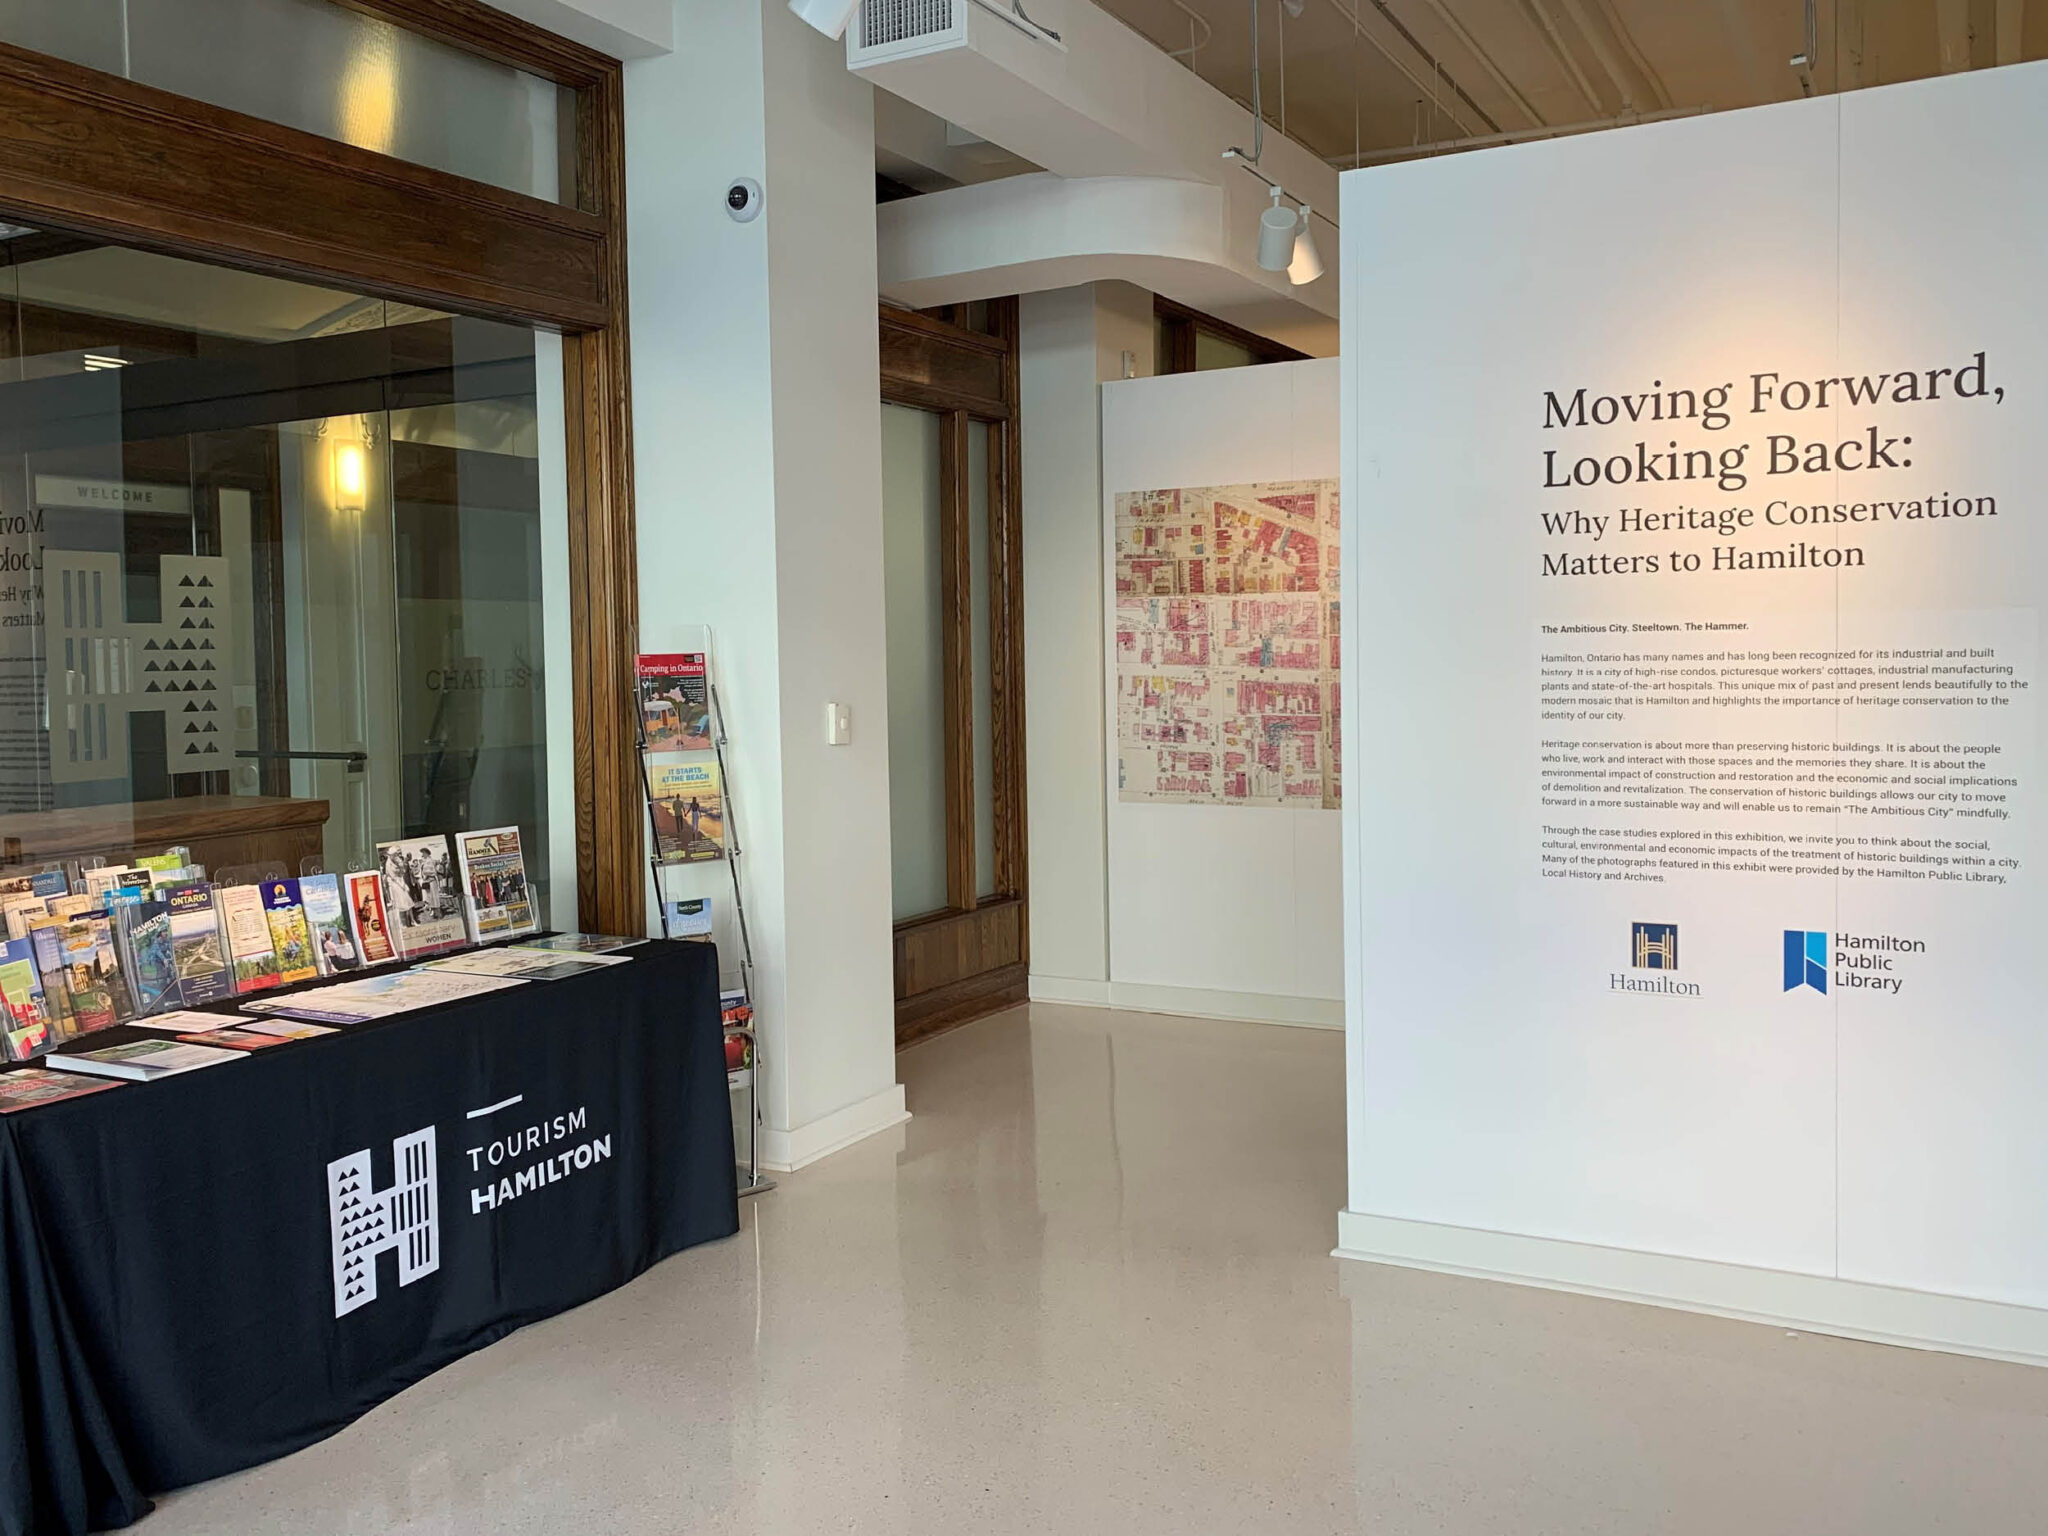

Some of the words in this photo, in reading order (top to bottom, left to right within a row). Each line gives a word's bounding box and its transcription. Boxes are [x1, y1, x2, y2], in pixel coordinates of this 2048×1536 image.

[1542, 380, 1733, 431] Moving
[1749, 351, 2005, 414] Forward,
[1542, 440, 1750, 491] Looking
[1766, 426, 1913, 475] Back:
[77, 486, 153, 503] WELCOME
[1541, 510, 1609, 541] Why
[1618, 505, 1754, 536] Heritage
[1764, 491, 1998, 526] Conservation
[1541, 549, 1660, 577] Matters
[1669, 548, 1701, 573] to
[1712, 542, 1866, 571] Hamilton
[1541, 624, 1558, 634] The
[1560, 623, 1606, 634] Ambitious
[1684, 622, 1702, 632] The
[640, 664, 669, 674] Camping
[670, 664, 677, 672] in
[677, 663, 703, 672] Ontario
[1541, 696, 1576, 705] modern
[1578, 696, 1612, 705] mosaic
[1614, 696, 1632, 705] that
[1635, 696, 1643, 705] is
[1646, 696, 1689, 705] Hamilton
[1692, 696, 1710, 705] and
[1712, 696, 1760, 707] highlights
[1764, 696, 1779, 705] the
[1782, 696, 1840, 707] importance
[1842, 696, 1853, 704] of
[1856, 696, 1899, 707] heritage
[1902, 696, 1973, 704] conservation
[1976, 696, 1987, 704] to
[1991, 696, 2008, 704] the
[1541, 738, 1579, 750] Heritage
[1581, 739, 1641, 748] conservation
[1644, 739, 1652, 748] is
[1655, 739, 1682, 749] about
[1712, 740, 1734, 749] than
[1736, 740, 1788, 753] preserving
[1791, 741, 1829, 751] historic
[1886, 742, 1893, 752] It
[1896, 743, 1905, 752] is
[1908, 743, 1939, 752] about
[1942, 743, 1960, 752] the
[1963, 744, 2000, 756] people
[675, 766, 702, 775] STARTS
[686, 773, 709, 781] BEACH
[1541, 767, 1606, 778] environmental
[1608, 769, 1640, 781] impact
[1642, 769, 1652, 779] of
[1654, 770, 1715, 780] construction
[1718, 771, 1736, 780] and
[1738, 771, 1793, 781] restoration
[1796, 772, 1814, 782] and
[1817, 773, 1834, 782] the
[1836, 773, 1888, 783] economic
[1890, 774, 1910, 784] and
[1914, 775, 1946, 784] social
[1948, 775, 2017, 788] implications
[1541, 782, 1550, 791] of
[1552, 782, 1601, 792] demolition
[1603, 783, 1620, 793] and
[1689, 785, 1707, 795] The
[1709, 786, 1773, 796] conservation
[1775, 787, 1786, 796] of
[1788, 787, 1826, 797] historic
[1829, 788, 1877, 801] buildings
[1879, 790, 1914, 799] allows
[1916, 792, 1935, 800] our
[1938, 791, 1958, 803] city
[1961, 791, 1972, 801] to
[1542, 825, 1579, 838] Through
[1582, 826, 1596, 836] the
[1623, 827, 1657, 837] studies
[1659, 829, 1700, 841] explored
[1702, 830, 1712, 839] in
[1714, 830, 1732, 840] this
[1805, 833, 1833, 843] invite
[1835, 837, 1854, 847] you
[1857, 835, 1868, 845] to
[1870, 836, 1897, 846] think
[1900, 837, 1930, 847] about
[1934, 838, 1951, 848] the
[1580, 840, 1645, 851] environmental
[1648, 843, 1666, 852] and
[1668, 843, 1715, 854] economic
[1717, 845, 1757, 858] impacts
[1759, 847, 1770, 856] of
[1772, 847, 1788, 857] the
[1791, 848, 1840, 859] treatment
[1843, 850, 1854, 860] of
[1856, 851, 1896, 862] historic
[1899, 853, 1948, 866] buildings
[1951, 855, 1985, 865] within
[1542, 853, 1566, 865] Many
[1568, 854, 1578, 863] of
[1580, 854, 1595, 864] the
[1596, 855, 1656, 869] photographs
[1658, 858, 1698, 868] featured
[1701, 860, 1709, 869] in
[1712, 860, 1730, 870] this
[1732, 861, 1766, 871] exhibit
[1768, 864, 1792, 872] were
[1795, 864, 1839, 877] provided
[1842, 866, 1854, 878] by
[1857, 866, 1874, 876] the
[1876, 867, 1925, 879] Hamilton
[1928, 870, 1962, 880] Public
[1542, 867, 1566, 877] Local
[1568, 868, 1601, 881] History
[1604, 870, 1621, 880] and
[170, 893, 208, 906] ONTARIO
[425, 933, 452, 944] WOMEN
[1834, 932, 1926, 953] Hamilton
[1834, 952, 1893, 971] Public
[1609, 973, 1701, 996] Hamilton
[1834, 971, 1903, 994] Library
[466, 1106, 587, 1172] TOURISM
[470, 1133, 612, 1215] HAMILTON
